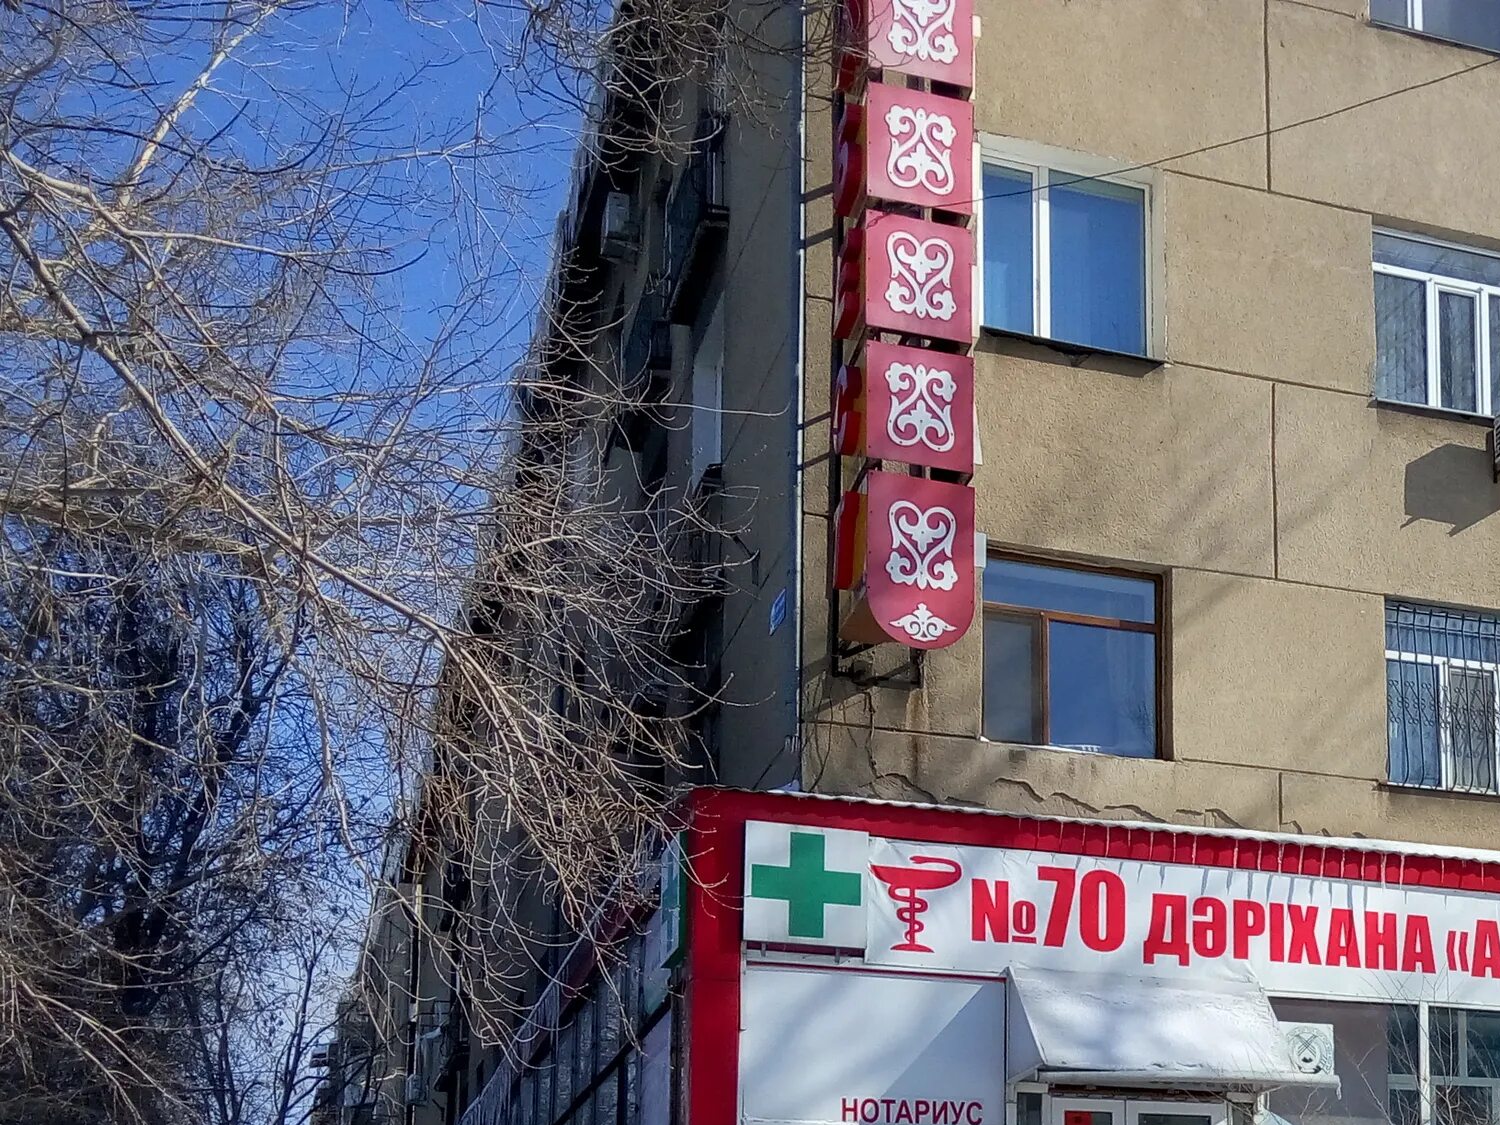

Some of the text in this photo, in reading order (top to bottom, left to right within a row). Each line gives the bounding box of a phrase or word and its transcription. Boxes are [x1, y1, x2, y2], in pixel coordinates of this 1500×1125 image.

[971, 865, 1126, 952] №70
[1143, 892, 1437, 974] ДӘРІХАНА
[841, 1097, 983, 1125] НОТАРИУС
